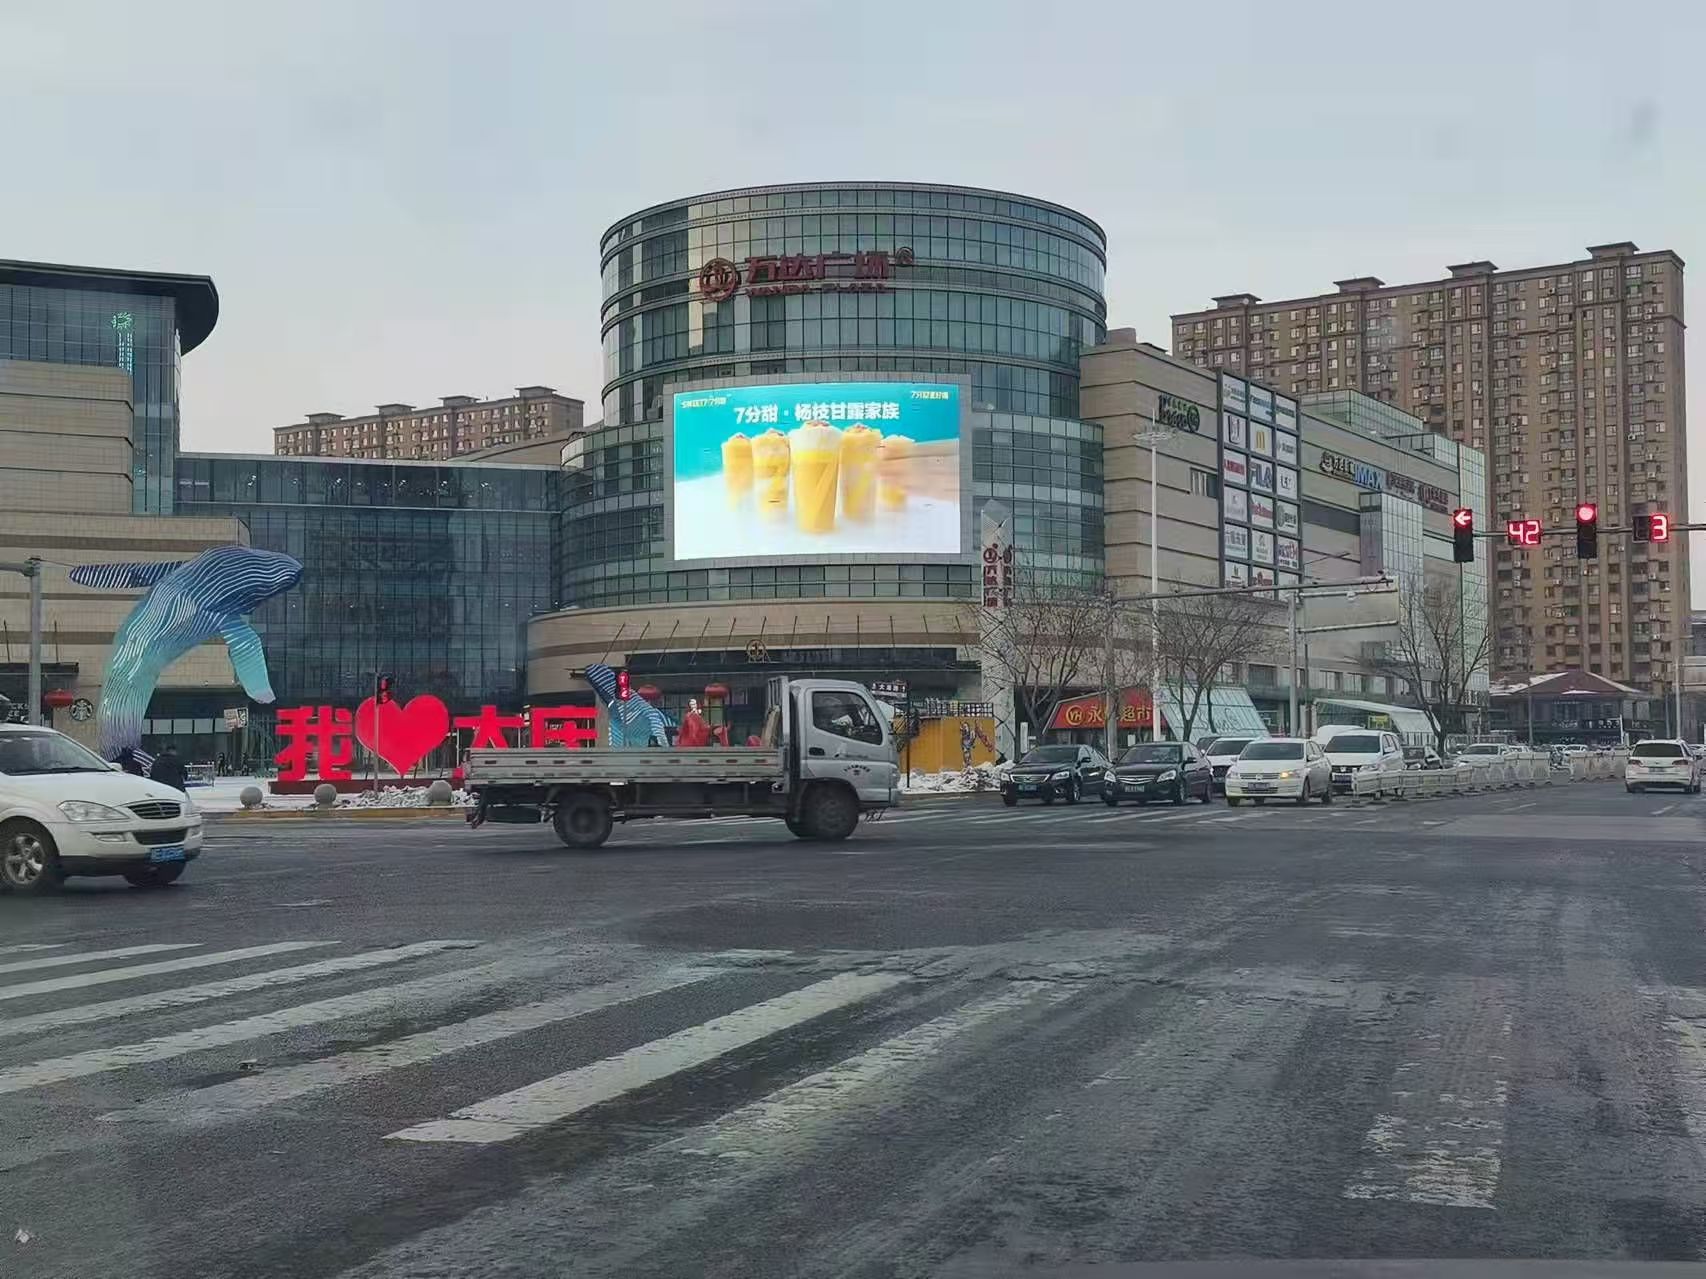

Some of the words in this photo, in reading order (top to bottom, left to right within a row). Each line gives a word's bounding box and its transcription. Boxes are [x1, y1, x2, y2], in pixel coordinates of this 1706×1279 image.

[1354, 463, 1383, 490] IMAX
[1508, 520, 1540, 545] 42
[1651, 515, 1669, 541] 3
[1088, 704, 1152, 723] 永超市
[273, 705, 353, 782] 我
